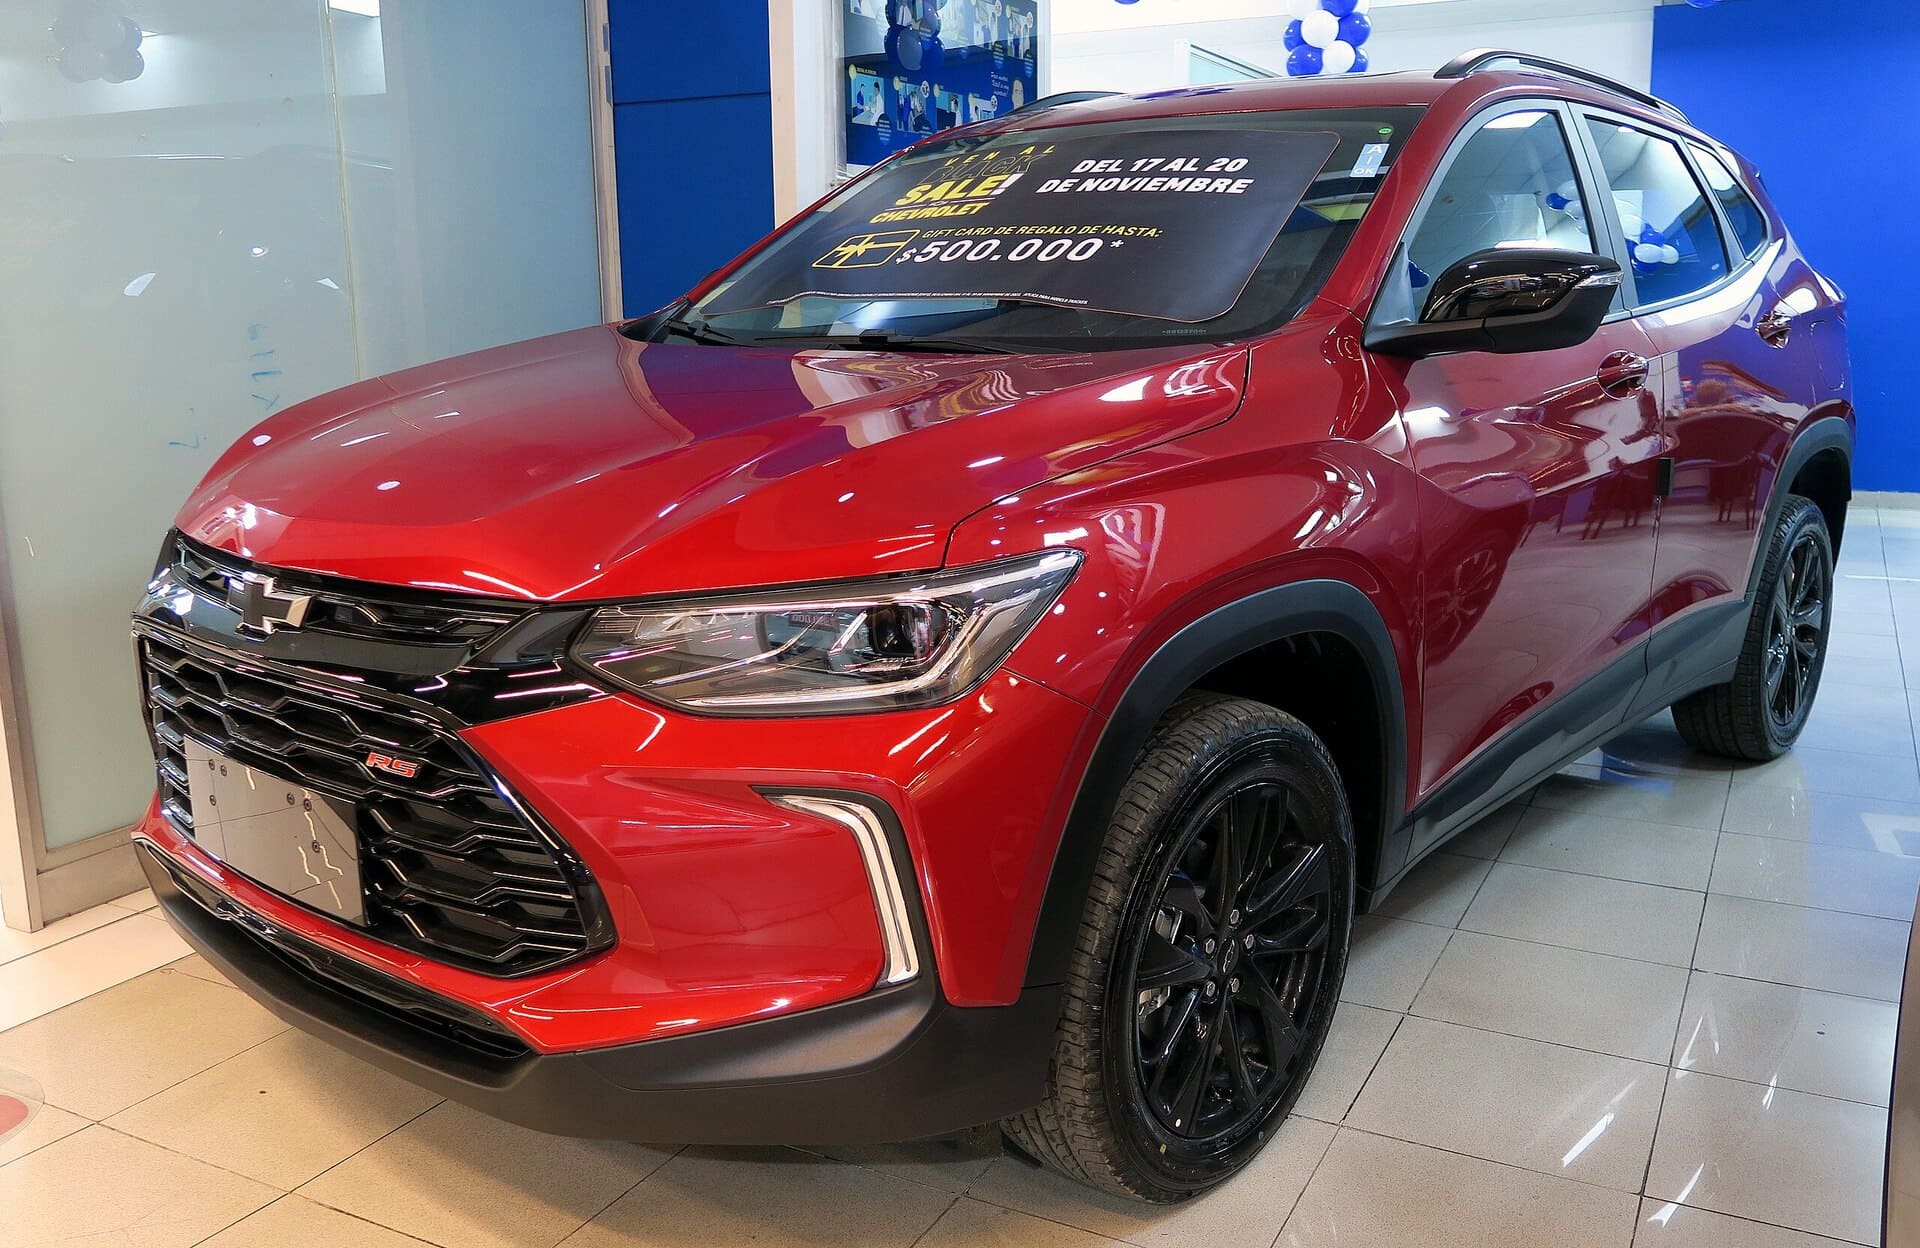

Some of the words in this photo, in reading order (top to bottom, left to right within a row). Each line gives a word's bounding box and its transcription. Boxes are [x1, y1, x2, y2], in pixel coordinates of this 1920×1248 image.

[945, 151, 1000, 167] VEN
[1020, 145, 1055, 155] AL
[1071, 159, 1124, 173] DEL
[1129, 158, 1166, 172] 17
[1160, 157, 1200, 172] AL
[1204, 157, 1249, 173] 20
[1354, 167, 1376, 175] OK
[896, 173, 1024, 206] SALE!
[1035, 178, 1080, 193] DE
[1075, 177, 1255, 194] NOVIEMBRE
[870, 202, 990, 224] CHEVROLET
[921, 228, 957, 239] GIFT
[956, 226, 994, 237] CARD
[993, 225, 1016, 236] DE
[1015, 225, 1078, 236] REGALO
[1079, 225, 1102, 235] DE
[1101, 225, 1164, 239] HASTA:
[366, 752, 417, 778] RS
